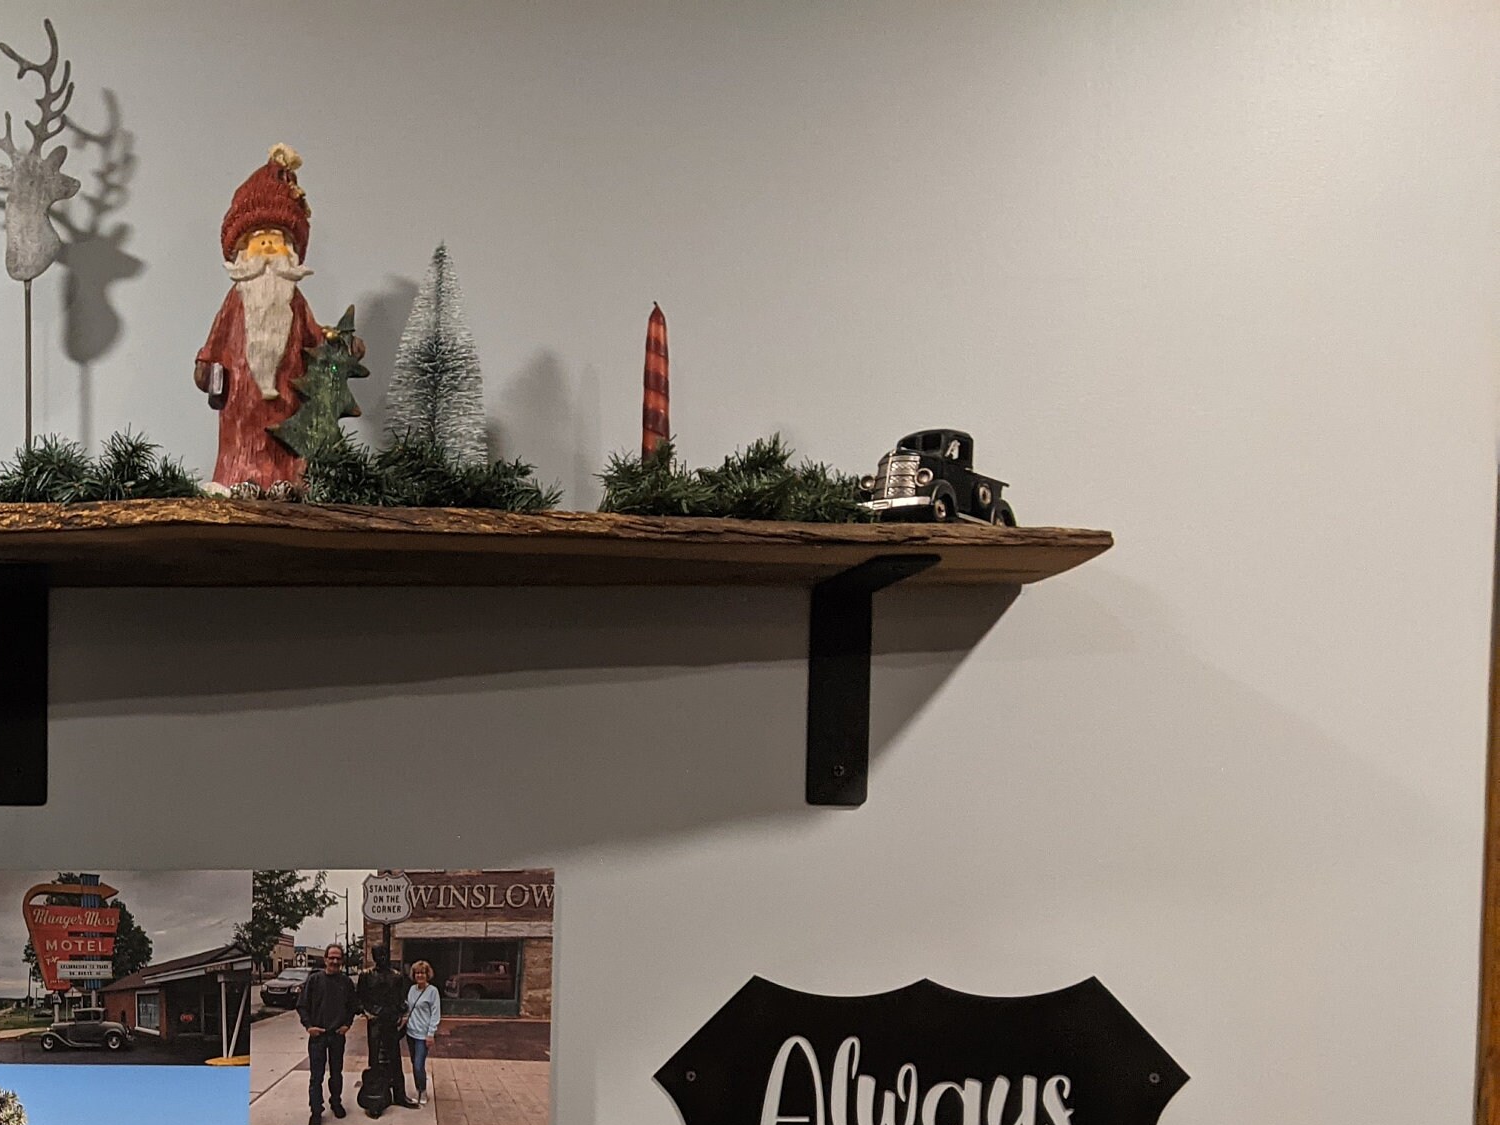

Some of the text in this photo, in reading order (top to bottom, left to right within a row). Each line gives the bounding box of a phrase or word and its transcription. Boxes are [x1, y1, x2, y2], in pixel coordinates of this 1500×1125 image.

[369, 884, 405, 893] STANDIN'
[373, 895, 400, 904] ON THE
[409, 883, 555, 909] WINSLOW
[371, 905, 402, 914] CORNER
[33, 907, 83, 929] Munger
[45, 939, 107, 952] MOTEL
